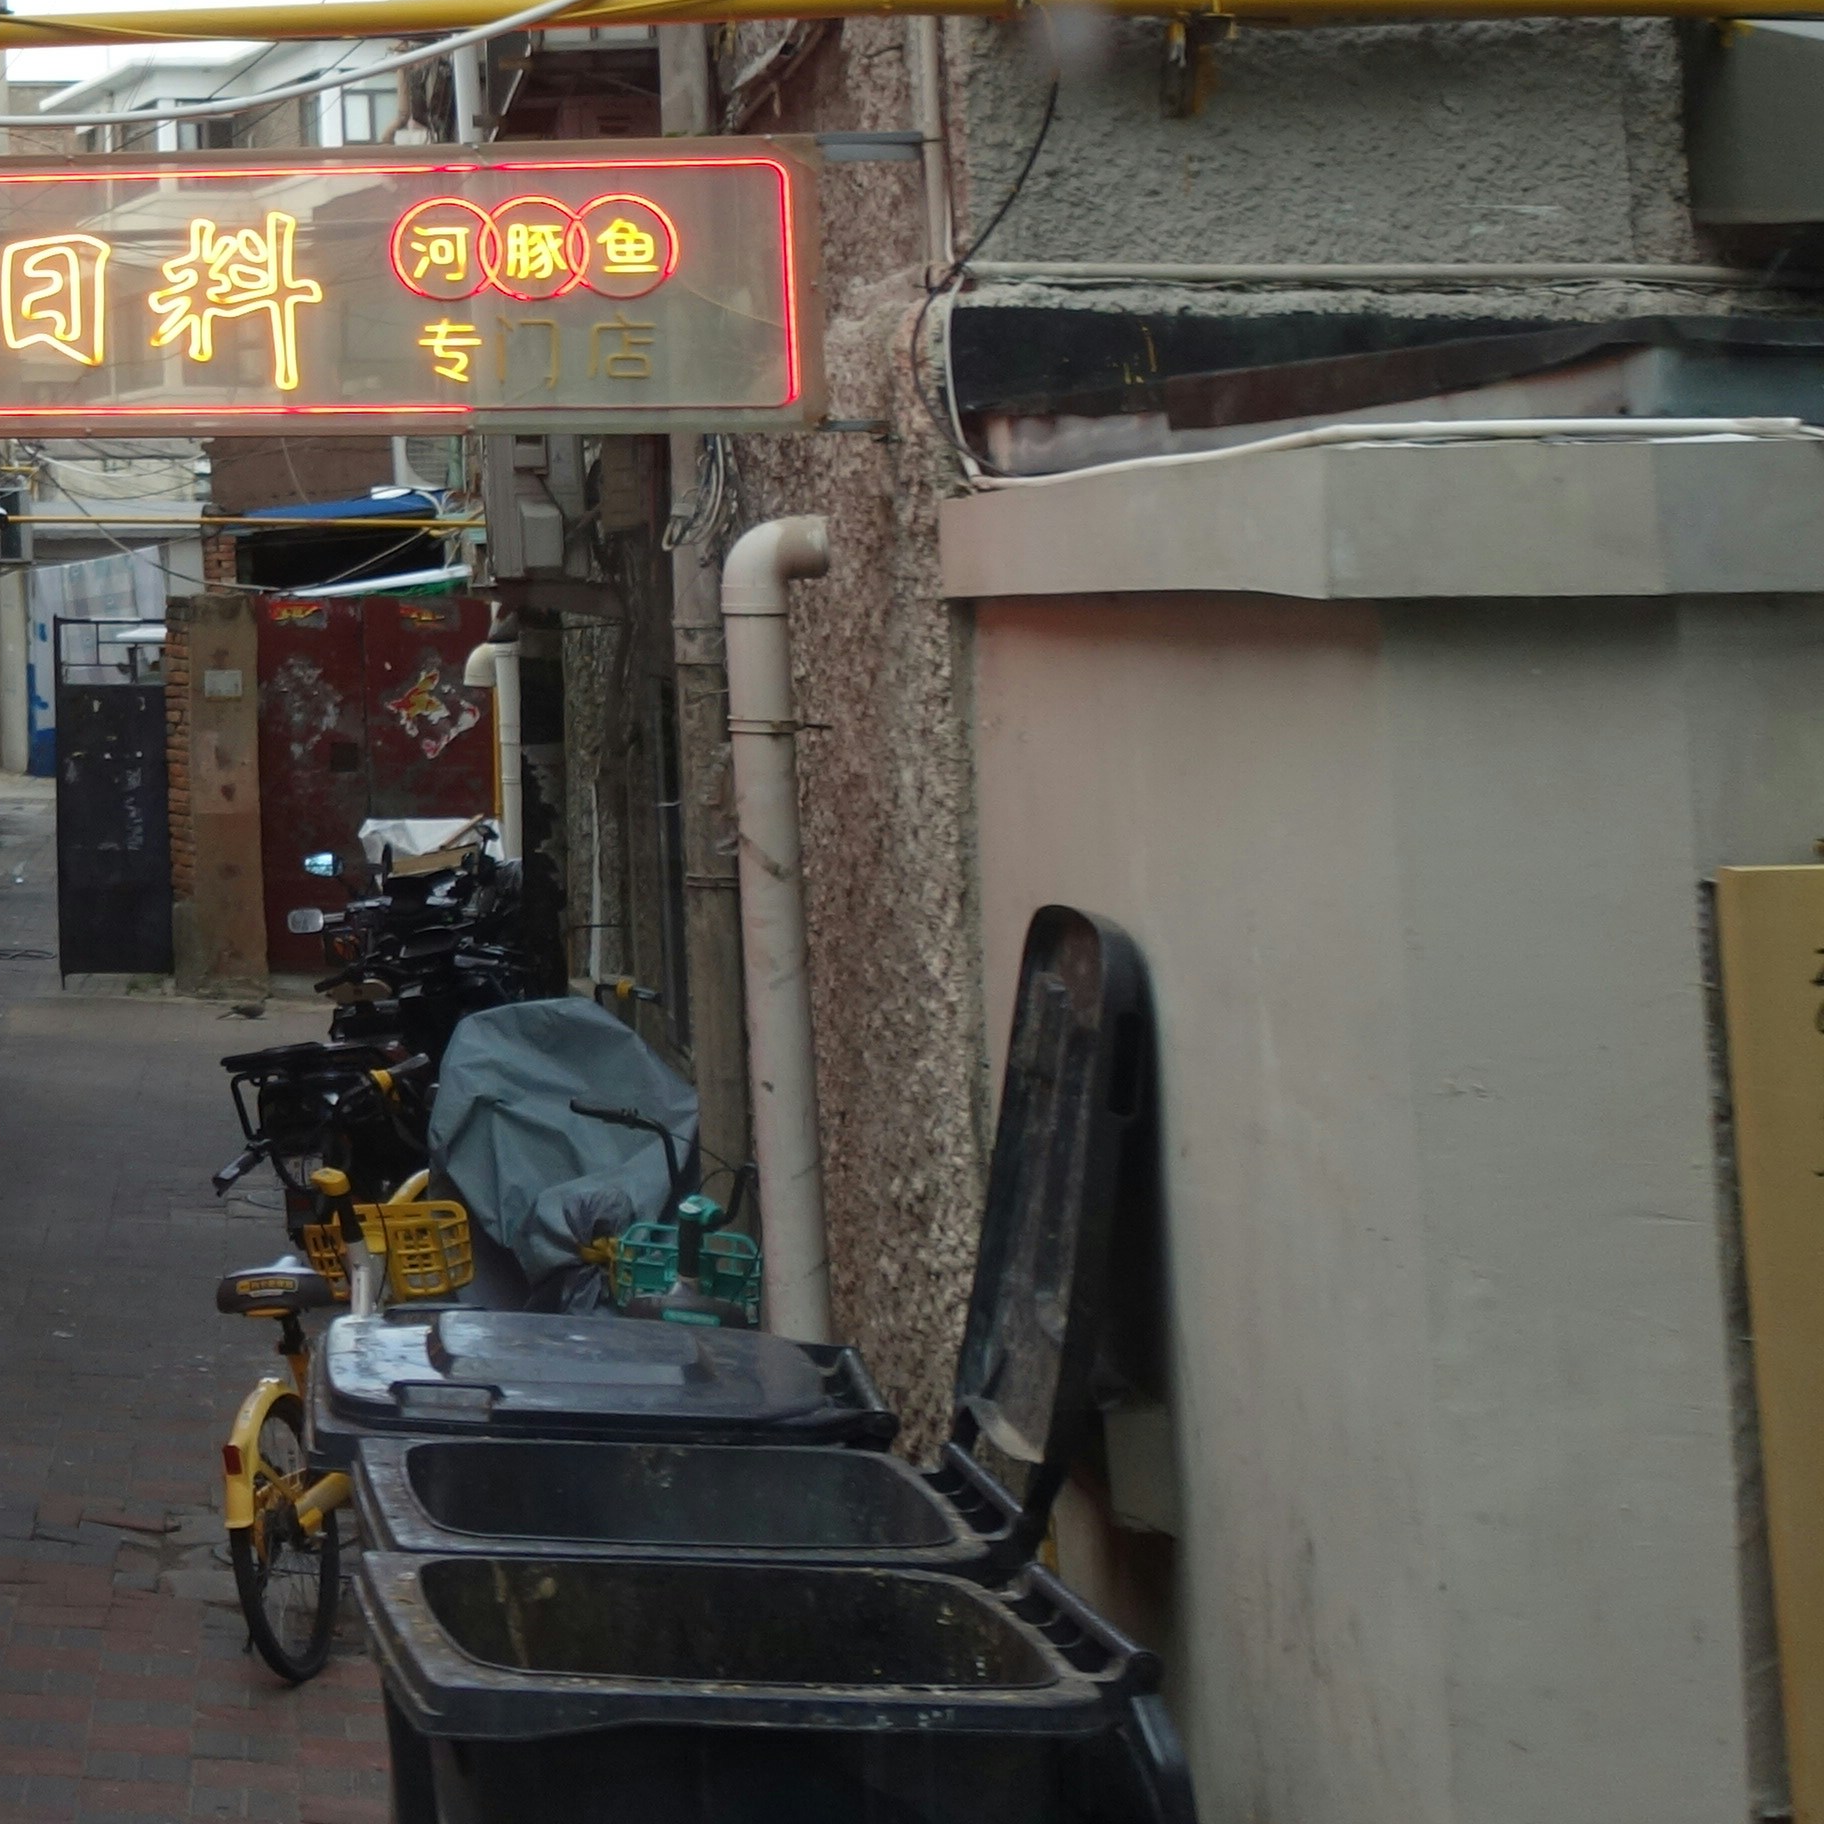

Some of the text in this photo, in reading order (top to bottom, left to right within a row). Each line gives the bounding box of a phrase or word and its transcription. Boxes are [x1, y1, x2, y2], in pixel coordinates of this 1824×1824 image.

[409, 218, 659, 282] 河豚鱼
[418, 310, 657, 390] 专门店
